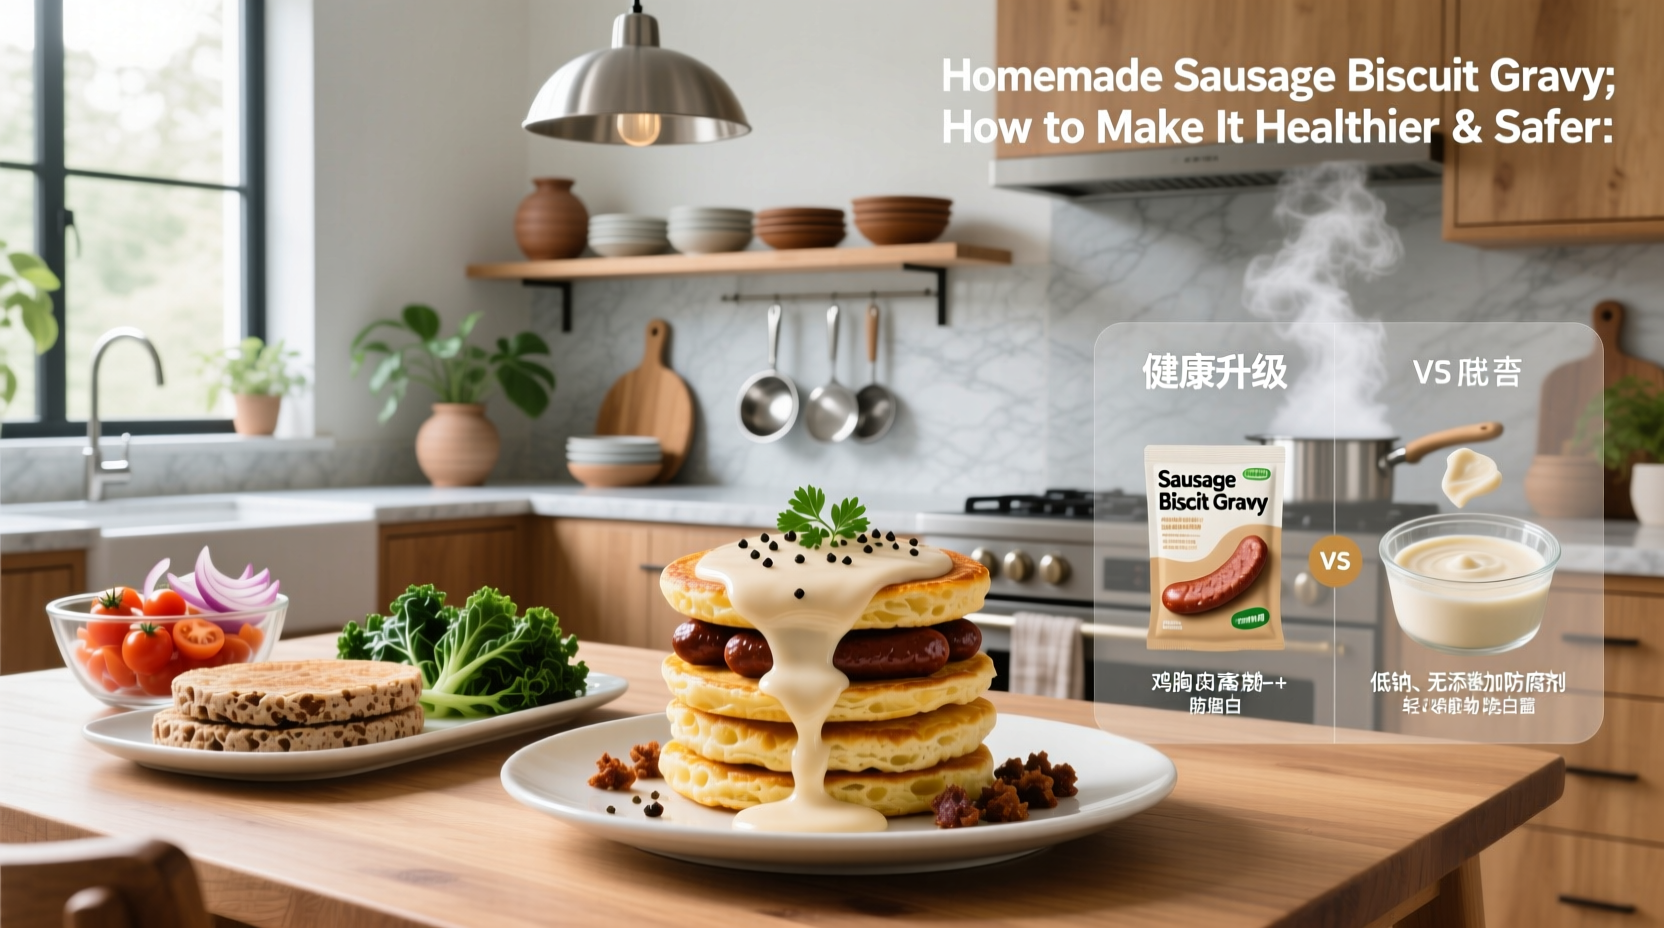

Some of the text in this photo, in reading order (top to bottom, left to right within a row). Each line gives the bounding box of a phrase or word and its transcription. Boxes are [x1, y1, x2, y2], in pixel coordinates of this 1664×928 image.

[1158, 469, 1237, 492] Sausage
[1159, 491, 1269, 517] Biscit Gravy
